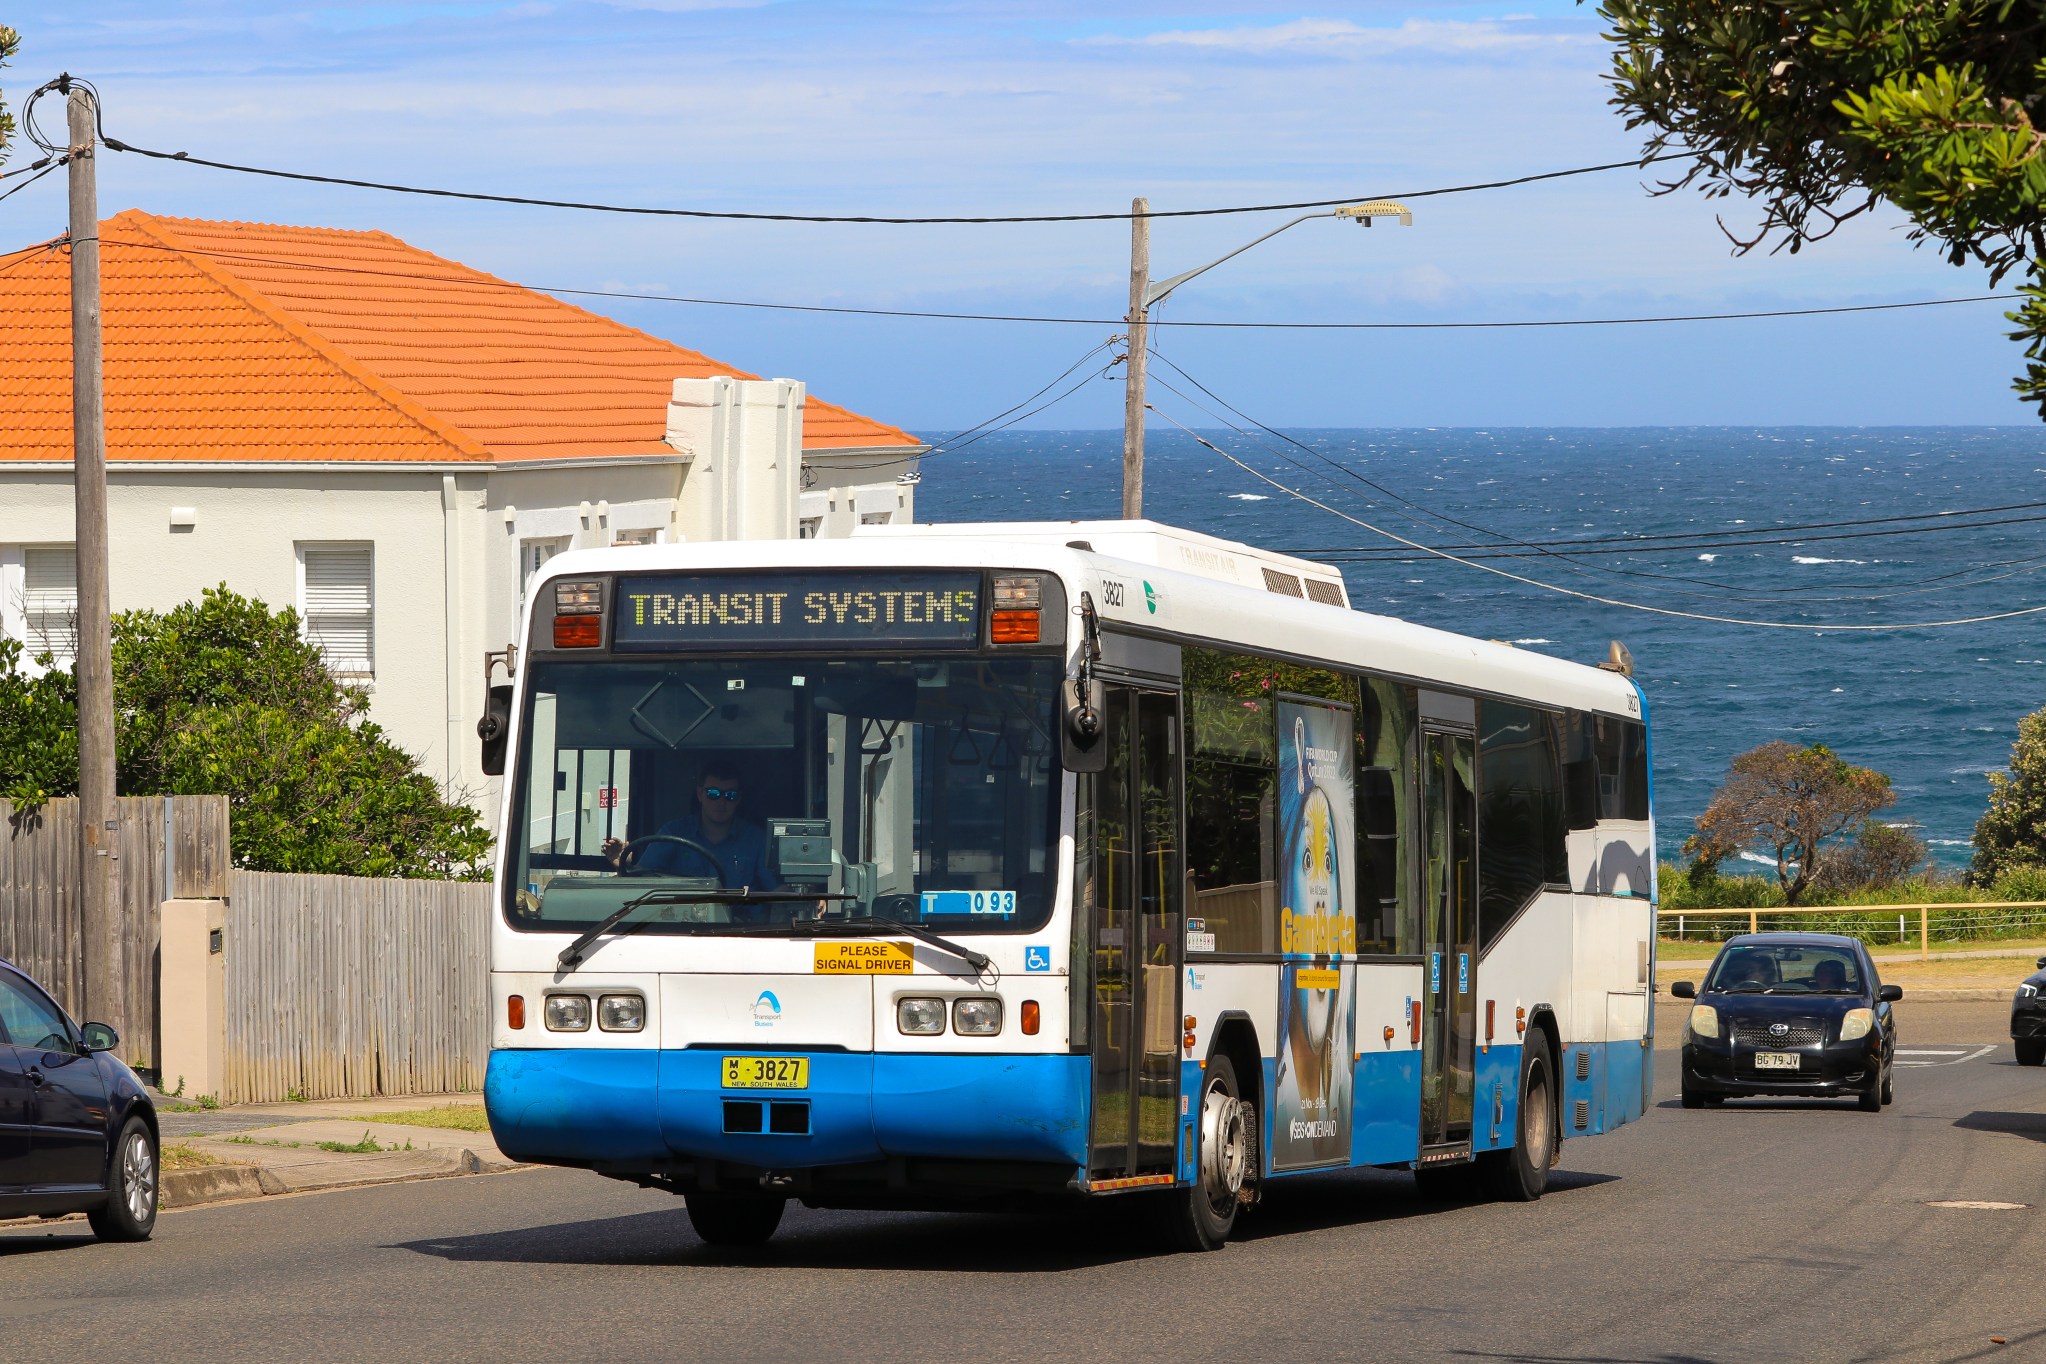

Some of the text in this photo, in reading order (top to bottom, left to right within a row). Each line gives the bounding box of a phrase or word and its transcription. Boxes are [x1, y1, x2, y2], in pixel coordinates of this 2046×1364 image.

[1103, 580, 1124, 607] 3827
[629, 591, 976, 626] TRANSIT SYSTEMS
[1626, 693, 1639, 712] 3827
[1306, 747, 1338, 762] FIFA WORLD CUP
[922, 892, 1014, 912] T 093
[1281, 907, 1357, 954] Gambeta
[840, 946, 887, 956] PLEASE
[816, 959, 911, 970] SIGNAL DRIVER
[1757, 1054, 1798, 1065] BG 79 JV
[754, 1060, 800, 1081] 3827
